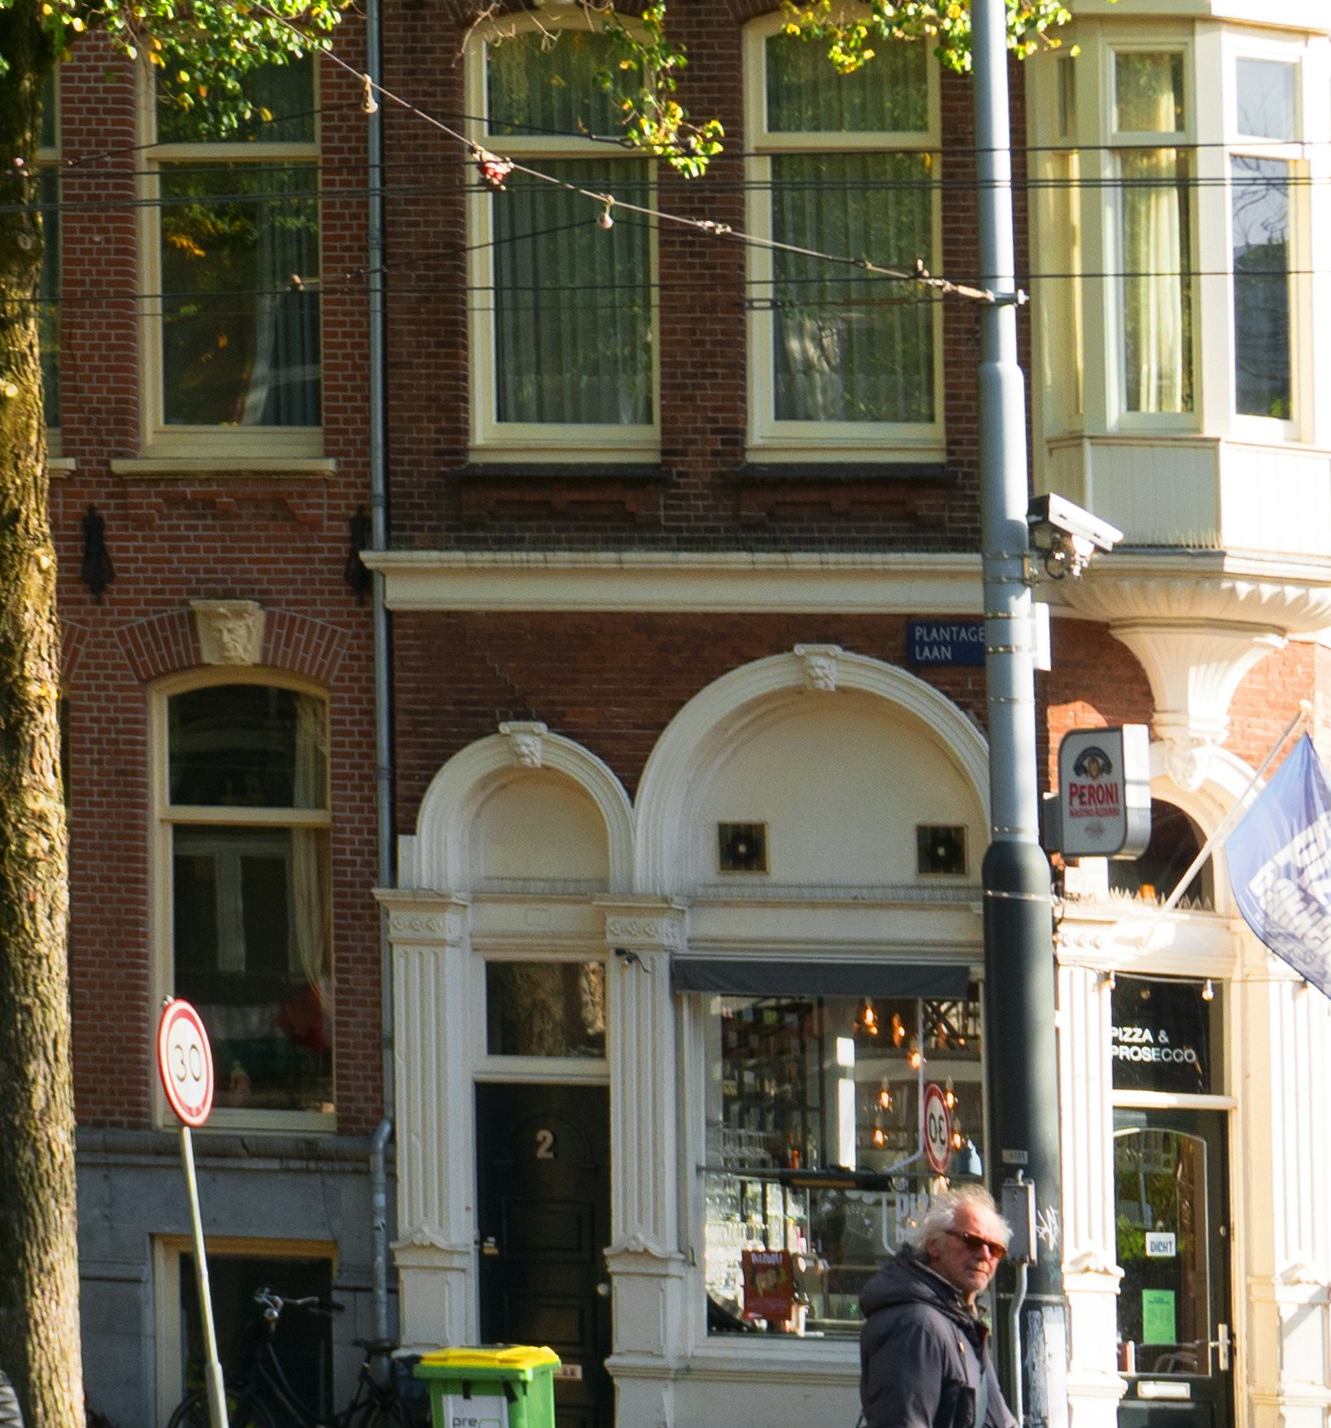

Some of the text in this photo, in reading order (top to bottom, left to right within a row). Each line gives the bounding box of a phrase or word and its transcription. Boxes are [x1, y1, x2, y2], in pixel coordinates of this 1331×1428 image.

[915, 626, 986, 643] PLANTAGE
[915, 646, 952, 661] LAAN
[1069, 782, 1119, 806] PERONI
[1112, 1026, 1169, 1044] PIZZA &
[174, 1044, 202, 1082] 30
[1112, 1045, 1196, 1063] PROSECCO
[536, 1129, 554, 1159] 2
[1150, 1240, 1173, 1253] DICHT
[452, 1417, 478, 1428] pre
